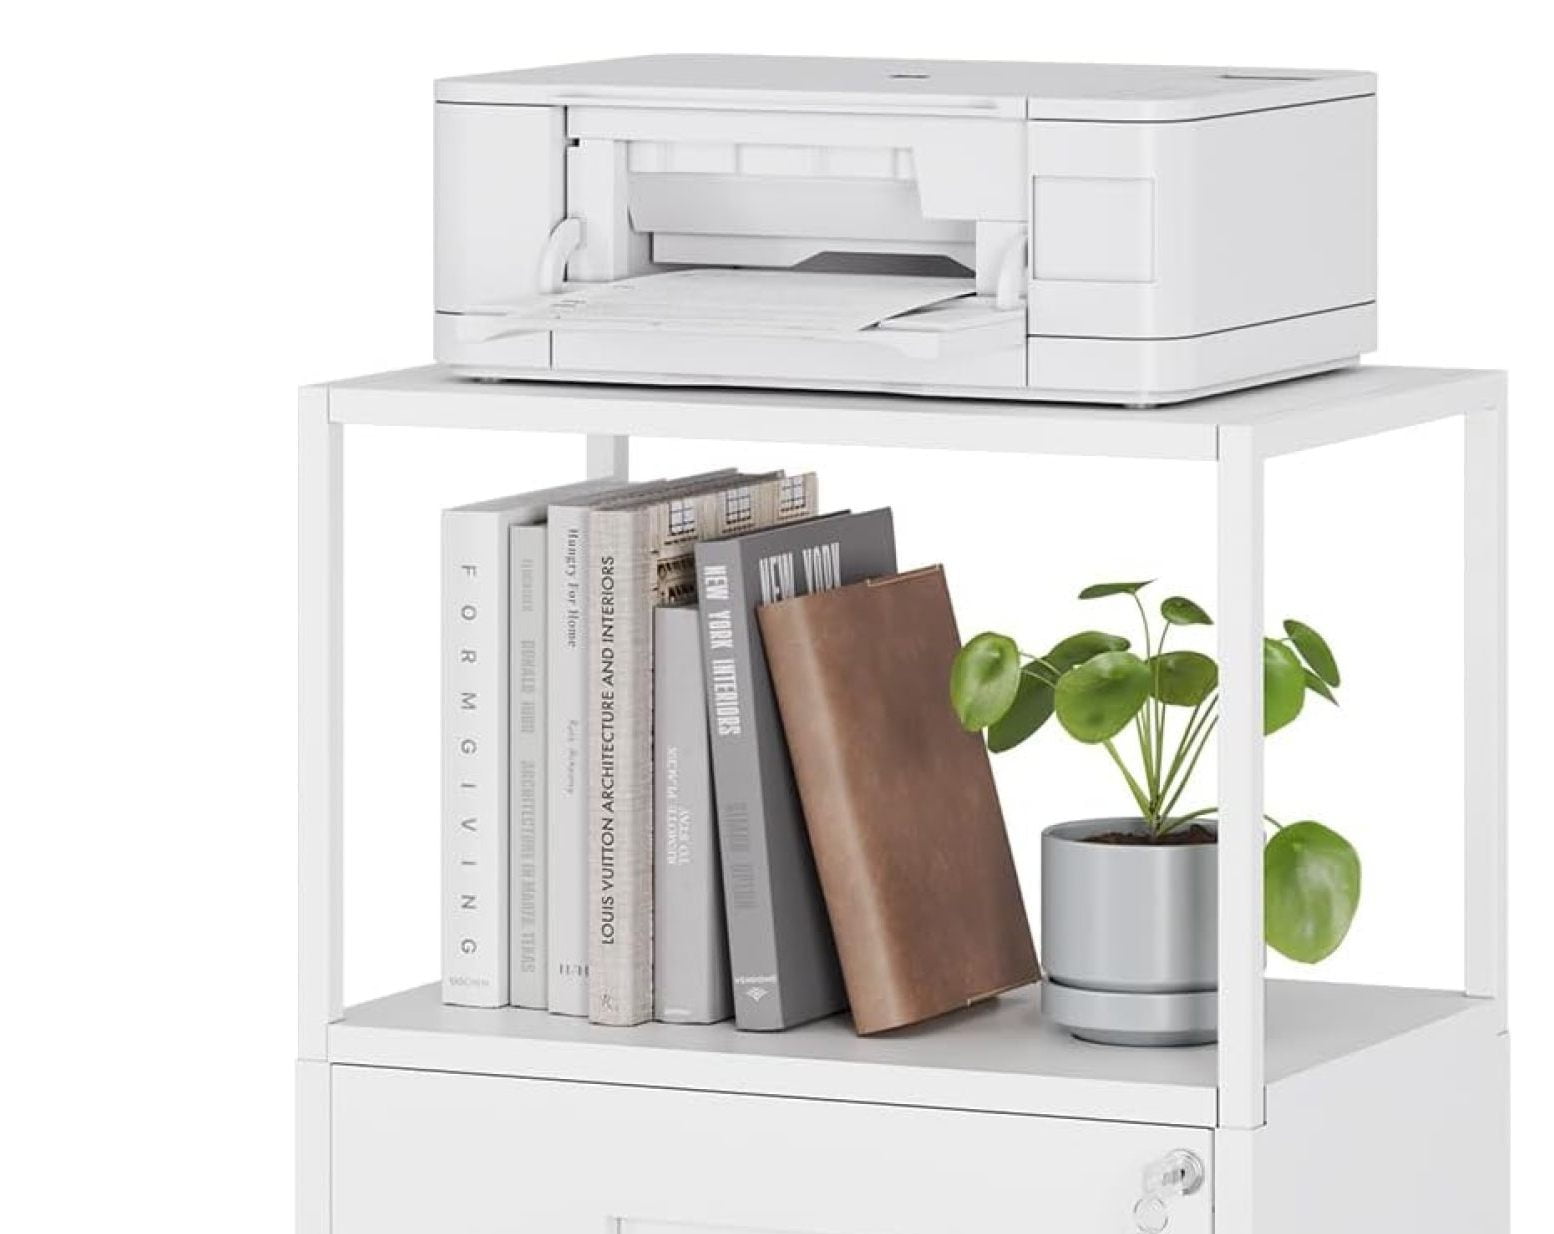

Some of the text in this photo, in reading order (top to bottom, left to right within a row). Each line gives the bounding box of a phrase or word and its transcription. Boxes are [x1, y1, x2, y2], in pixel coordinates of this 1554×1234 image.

[460, 565, 477, 955] FORMGIVING
[601, 555, 615, 945] LOUIS VUITTON ARCHITECTURE AND INTERIORS
[703, 565, 742, 736] NEW YORK INTERIORS
